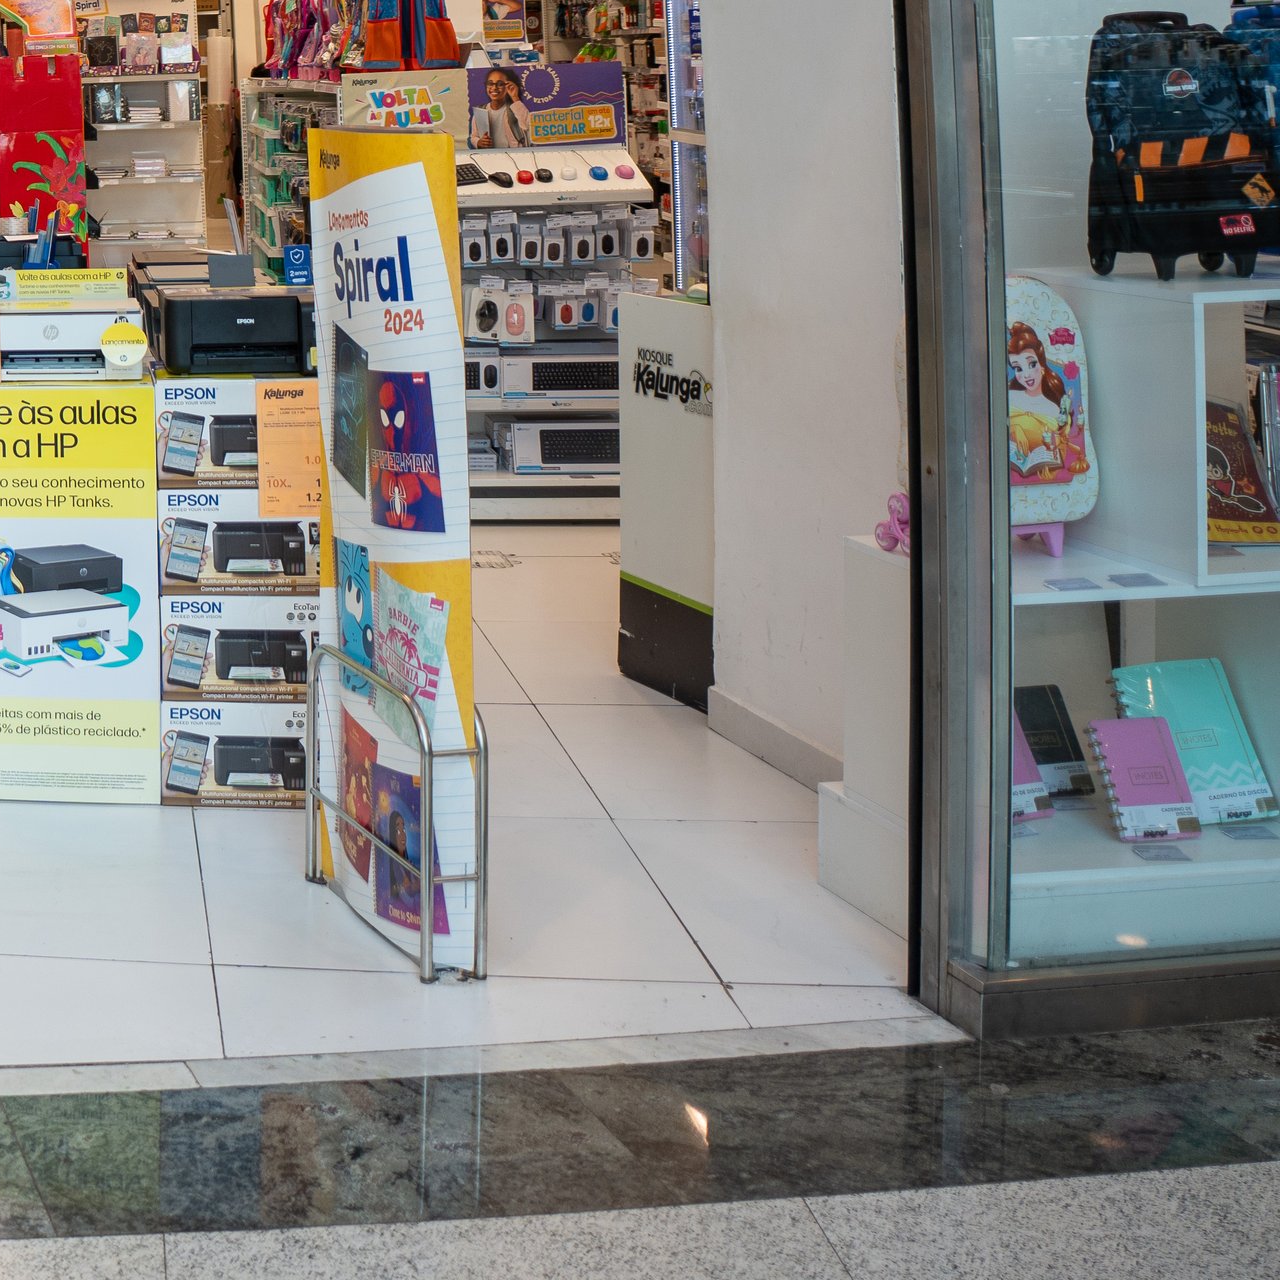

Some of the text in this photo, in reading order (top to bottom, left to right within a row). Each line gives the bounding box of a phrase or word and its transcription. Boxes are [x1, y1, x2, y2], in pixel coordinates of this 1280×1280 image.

[370, 88, 431, 109] VOLTA
[535, 123, 586, 137] ESCOLAR
[1223, 226, 1255, 235] NO SELFIES
[18, 272, 72, 281] Volte aulas
[333, 236, 414, 318] Spiral
[384, 308, 424, 335] 2024
[638, 347, 672, 366] KIOSQUE
[165, 388, 215, 399] EPSON
[18, 400, 53, 424] às
[60, 400, 137, 424] aulas
[13, 438, 30, 458] a
[37, 432, 78, 458] HP
[12, 479, 37, 488] seu
[41, 476, 145, 488] conhecimento
[0, 498, 42, 507] novas
[46, 495, 66, 507] HP
[70, 495, 113, 508] Tanks.
[168, 494, 219, 506] EPSON
[171, 601, 221, 613] EPSON
[389, 607, 419, 635] BARBIE
[26, 711, 52, 720] com
[55, 709, 83, 720] mais
[86, 710, 101, 721] de
[170, 708, 221, 720] EPSON
[16, 724, 31, 734] de
[33, 724, 80, 737] plástico
[1248, 788, 1268, 796] DISCOS
